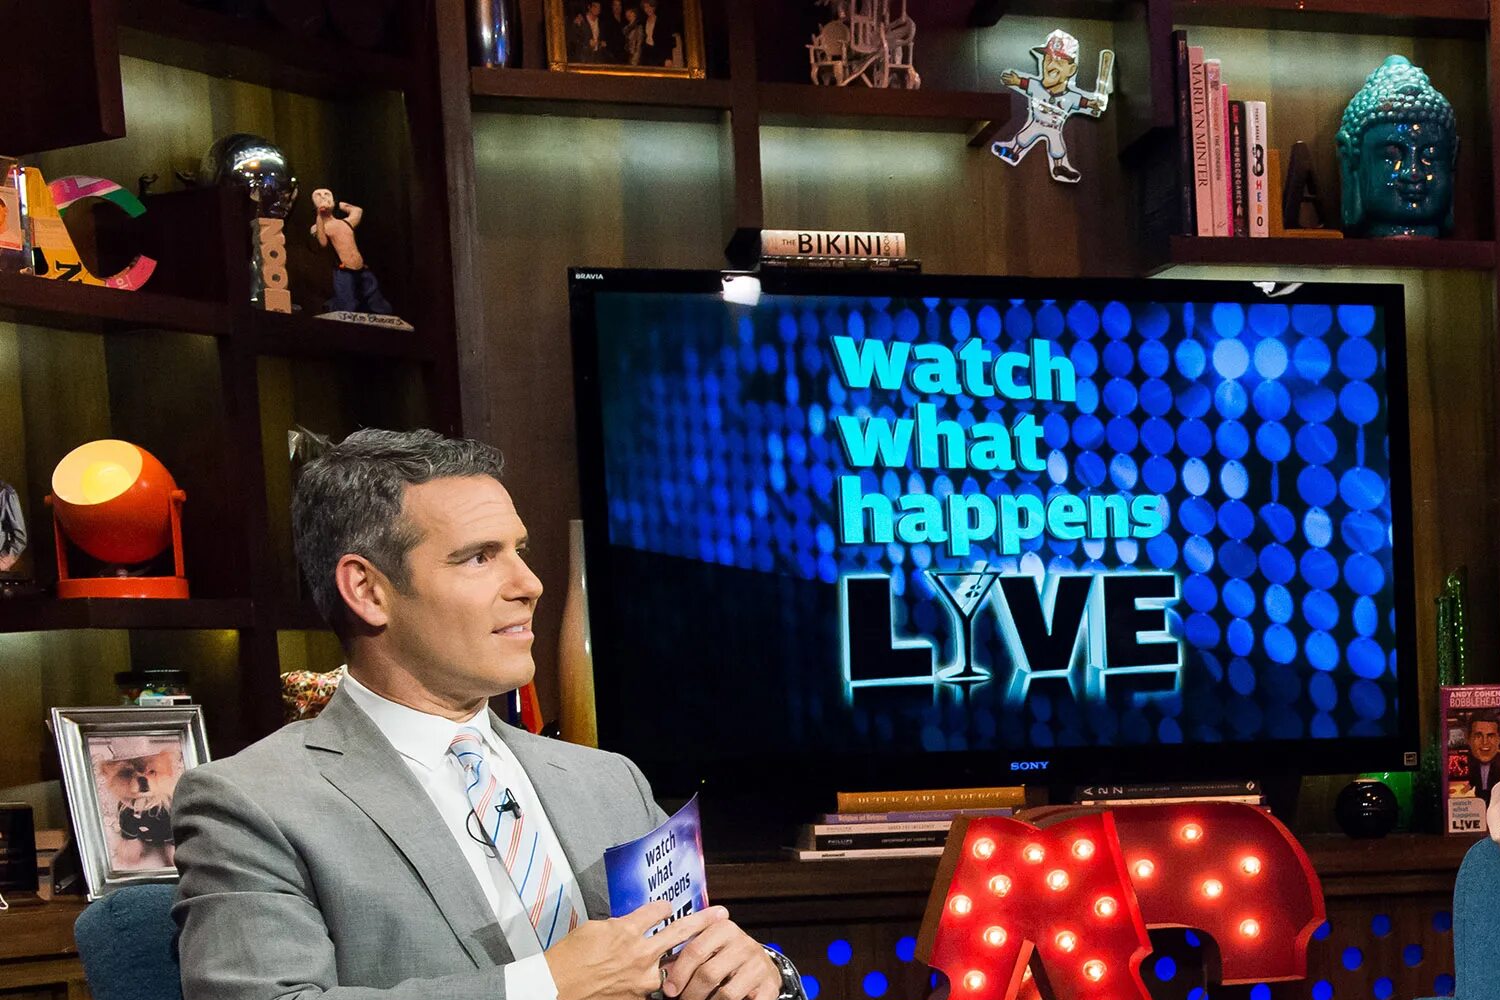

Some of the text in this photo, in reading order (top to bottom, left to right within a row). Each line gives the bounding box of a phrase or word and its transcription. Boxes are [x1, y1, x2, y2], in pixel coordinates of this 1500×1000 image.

[1191, 62, 1209, 188] MARILYN MINTER
[782, 238, 796, 247] THE
[797, 232, 882, 256] BIKINI
[832, 335, 1077, 402] watch
[837, 402, 1048, 472] what
[839, 475, 1165, 556] happens
[1450, 690, 1500, 699] ANDY COHEN
[1010, 761, 1049, 771] SONY
[645, 830, 676, 868] watch
[648, 859, 674, 893] what
